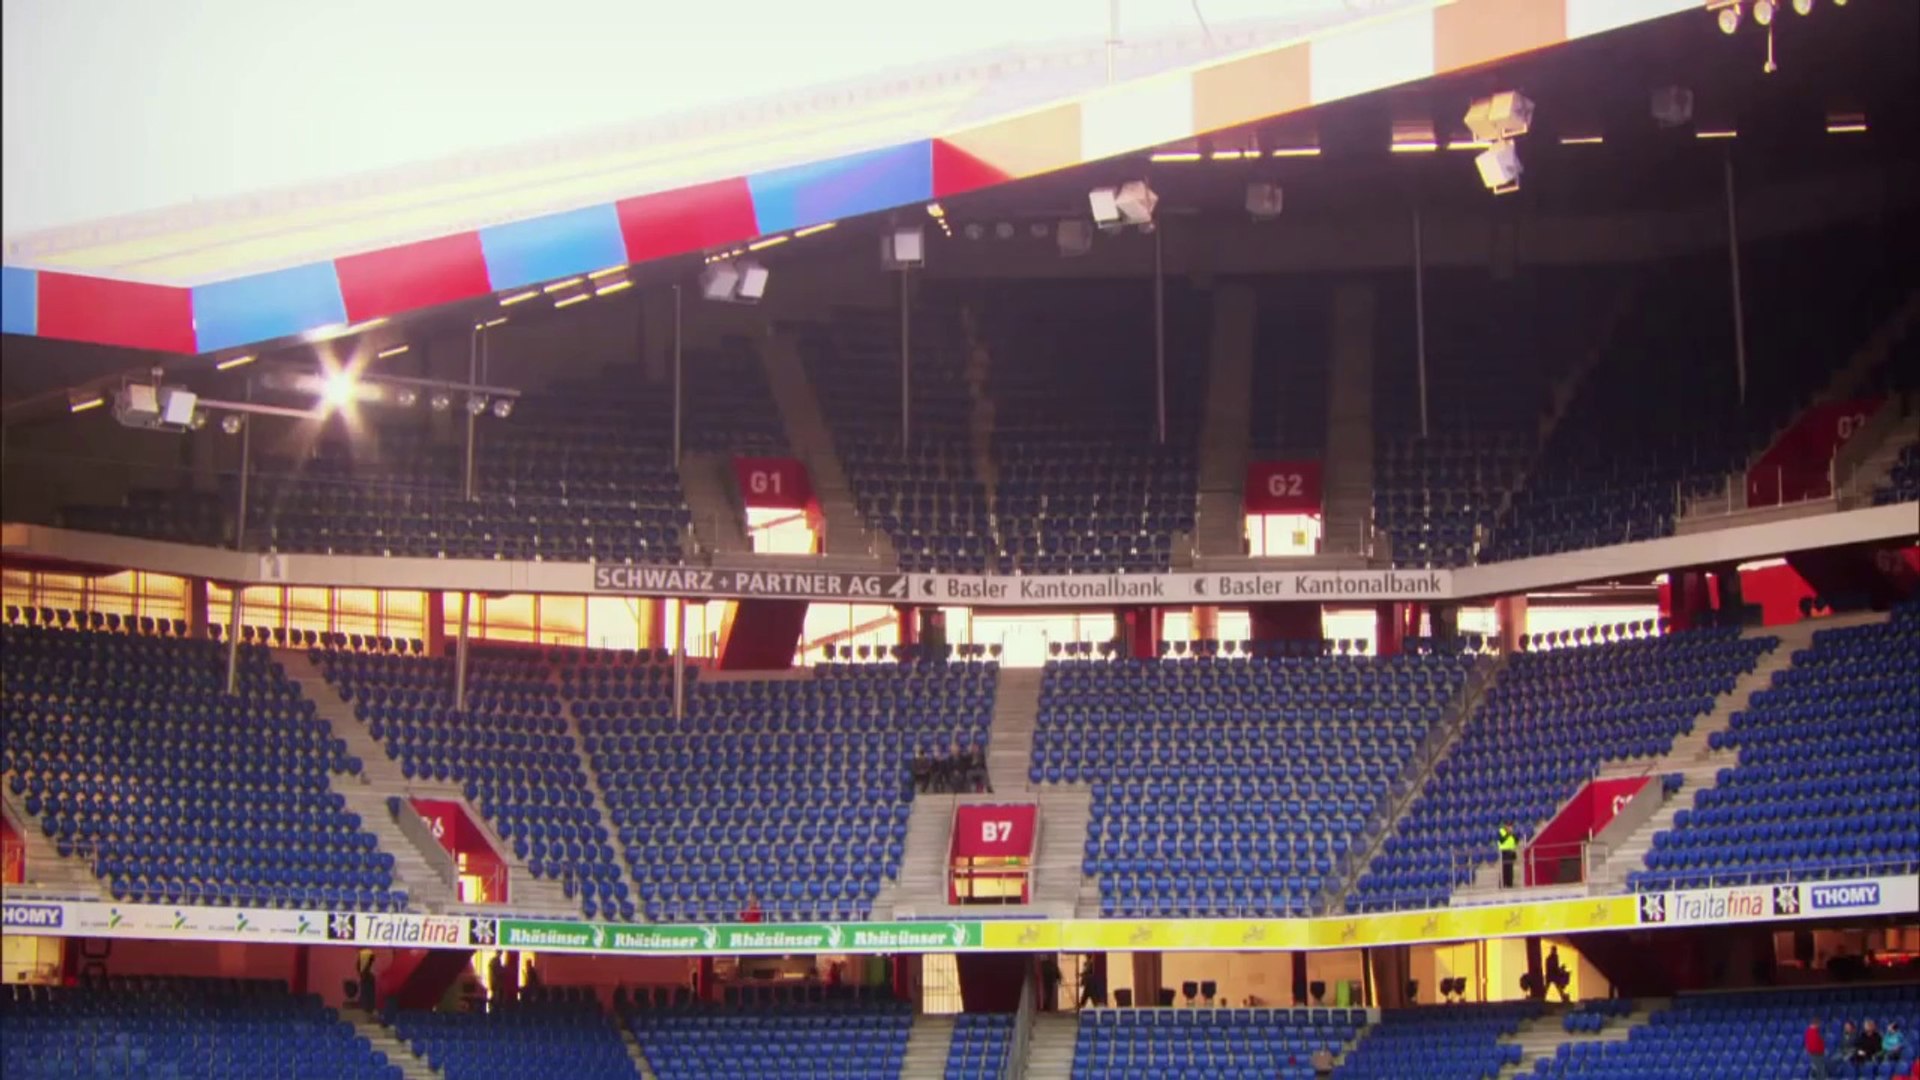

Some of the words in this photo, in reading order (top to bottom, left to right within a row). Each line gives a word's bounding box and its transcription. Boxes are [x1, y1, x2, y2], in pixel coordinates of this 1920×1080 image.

[750, 471, 780, 494] G1
[1269, 474, 1303, 496] G2
[598, 568, 714, 590] SCHWARZ
[719, 577, 729, 588] +
[735, 572, 842, 594] PARTNER
[848, 576, 882, 596] AG
[947, 578, 1008, 598] Basler
[1020, 577, 1164, 598] Kantonalbank
[1219, 576, 1283, 595] Basler
[1295, 573, 1441, 595] Kantonalbank
[982, 821, 1012, 842] B7
[1674, 889, 1763, 921] Traitafina
[1814, 886, 1877, 905] THOMY
[3, 907, 59, 925] HOMY
[366, 916, 460, 944] Traitafina
